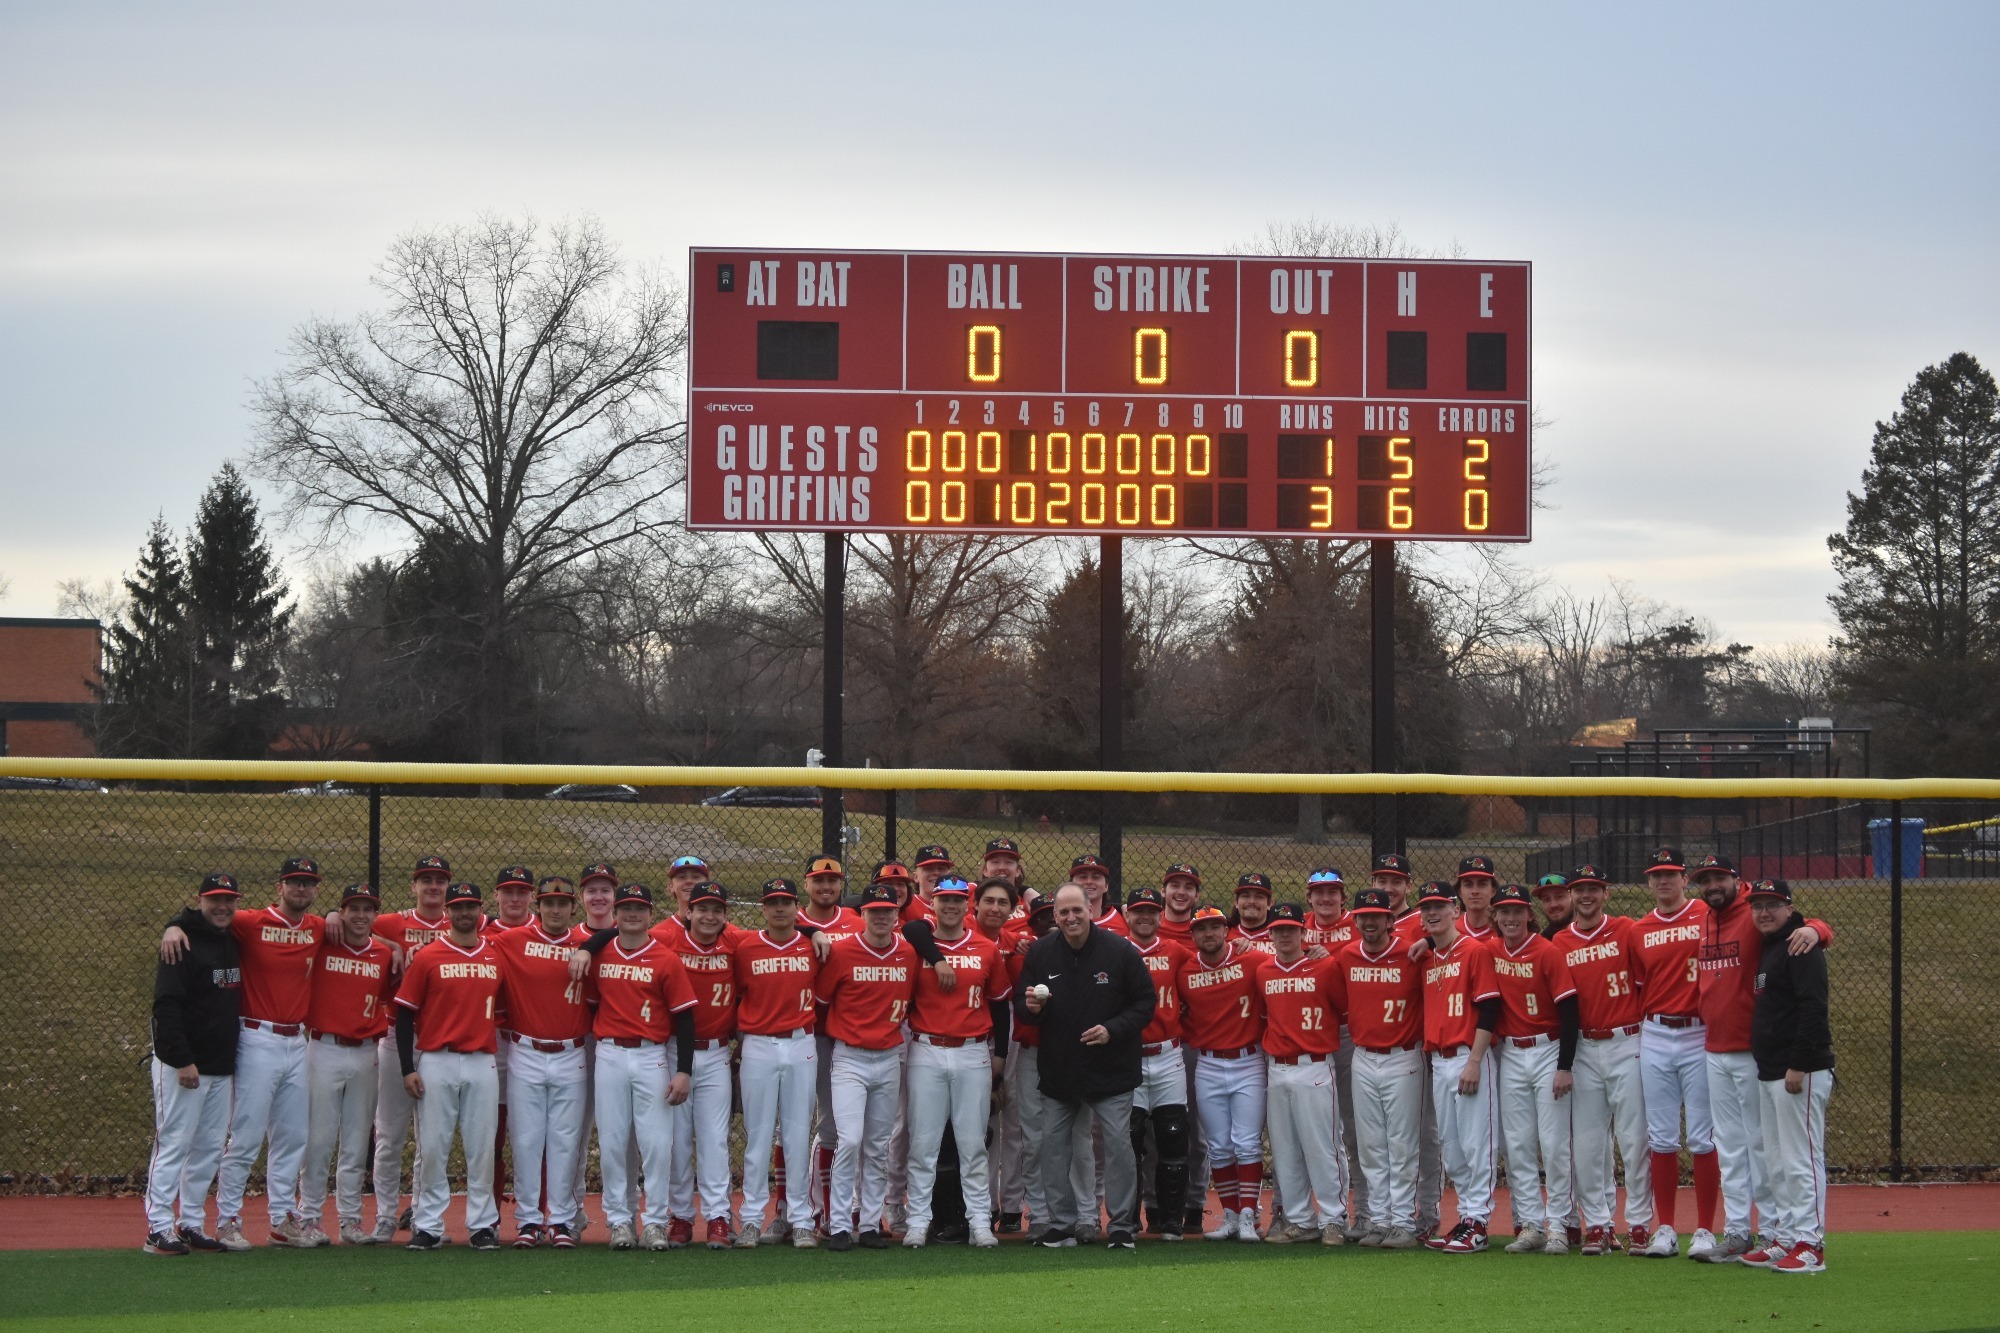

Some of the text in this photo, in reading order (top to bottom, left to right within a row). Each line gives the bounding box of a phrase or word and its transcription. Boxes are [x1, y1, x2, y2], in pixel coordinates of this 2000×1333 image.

[747, 261, 851, 306] AT BAT
[948, 264, 1022, 309] BALL
[1094, 266, 1209, 312] STRIKE
[1271, 269, 1333, 314] OUT
[1398, 272, 1416, 316] H
[1481, 273, 1493, 317] E
[969, 326, 1000, 381] 0
[1136, 328, 1166, 384] 0
[1286, 331, 1316, 386] 0
[713, 404, 754, 412] NEVCO
[916, 400, 1514, 432] 1 2 3 4 5 6 7 8 9 10 RUNS HITS ERRORS
[717, 425, 1488, 480] GUESTS 0 0 0 1 0 0 0 0 0 1 5 2
[724, 475, 1488, 529] GRIFFINS 0 0 1 0 2 0 0 0 3 6 0
[262, 926, 314, 944] GRIFFINS
[1643, 925, 1700, 949] GRIFFINS
[525, 941, 578, 961] GRIFFIN
[1566, 941, 1619, 967] GRIFFINS
[325, 955, 380, 979] GRIFFINS
[439, 963, 497, 980] GRIFFINS
[599, 963, 654, 983] GRIFFINS
[751, 956, 810, 975] GRIFFINS
[853, 966, 906, 982] GRIFFINS
[1350, 967, 1401, 983] GRIFFINS
[1426, 962, 1461, 984] GRIFFINS
[1699, 957, 1741, 970] ASEBALL
[1188, 963, 1244, 989] GRIFFINS
[1265, 977, 1316, 995] GRIFFINS
[1607, 971, 1630, 996] 33
[968, 985, 981, 1009] 13
[1159, 986, 1173, 1008] 14
[1239, 995, 1250, 1018] 2
[1448, 993, 1463, 1017] 18
[1526, 993, 1538, 1015] 9
[640, 1000, 651, 1022] 4
[1301, 1007, 1323, 1031] 32
[1383, 999, 1406, 1023] 27
